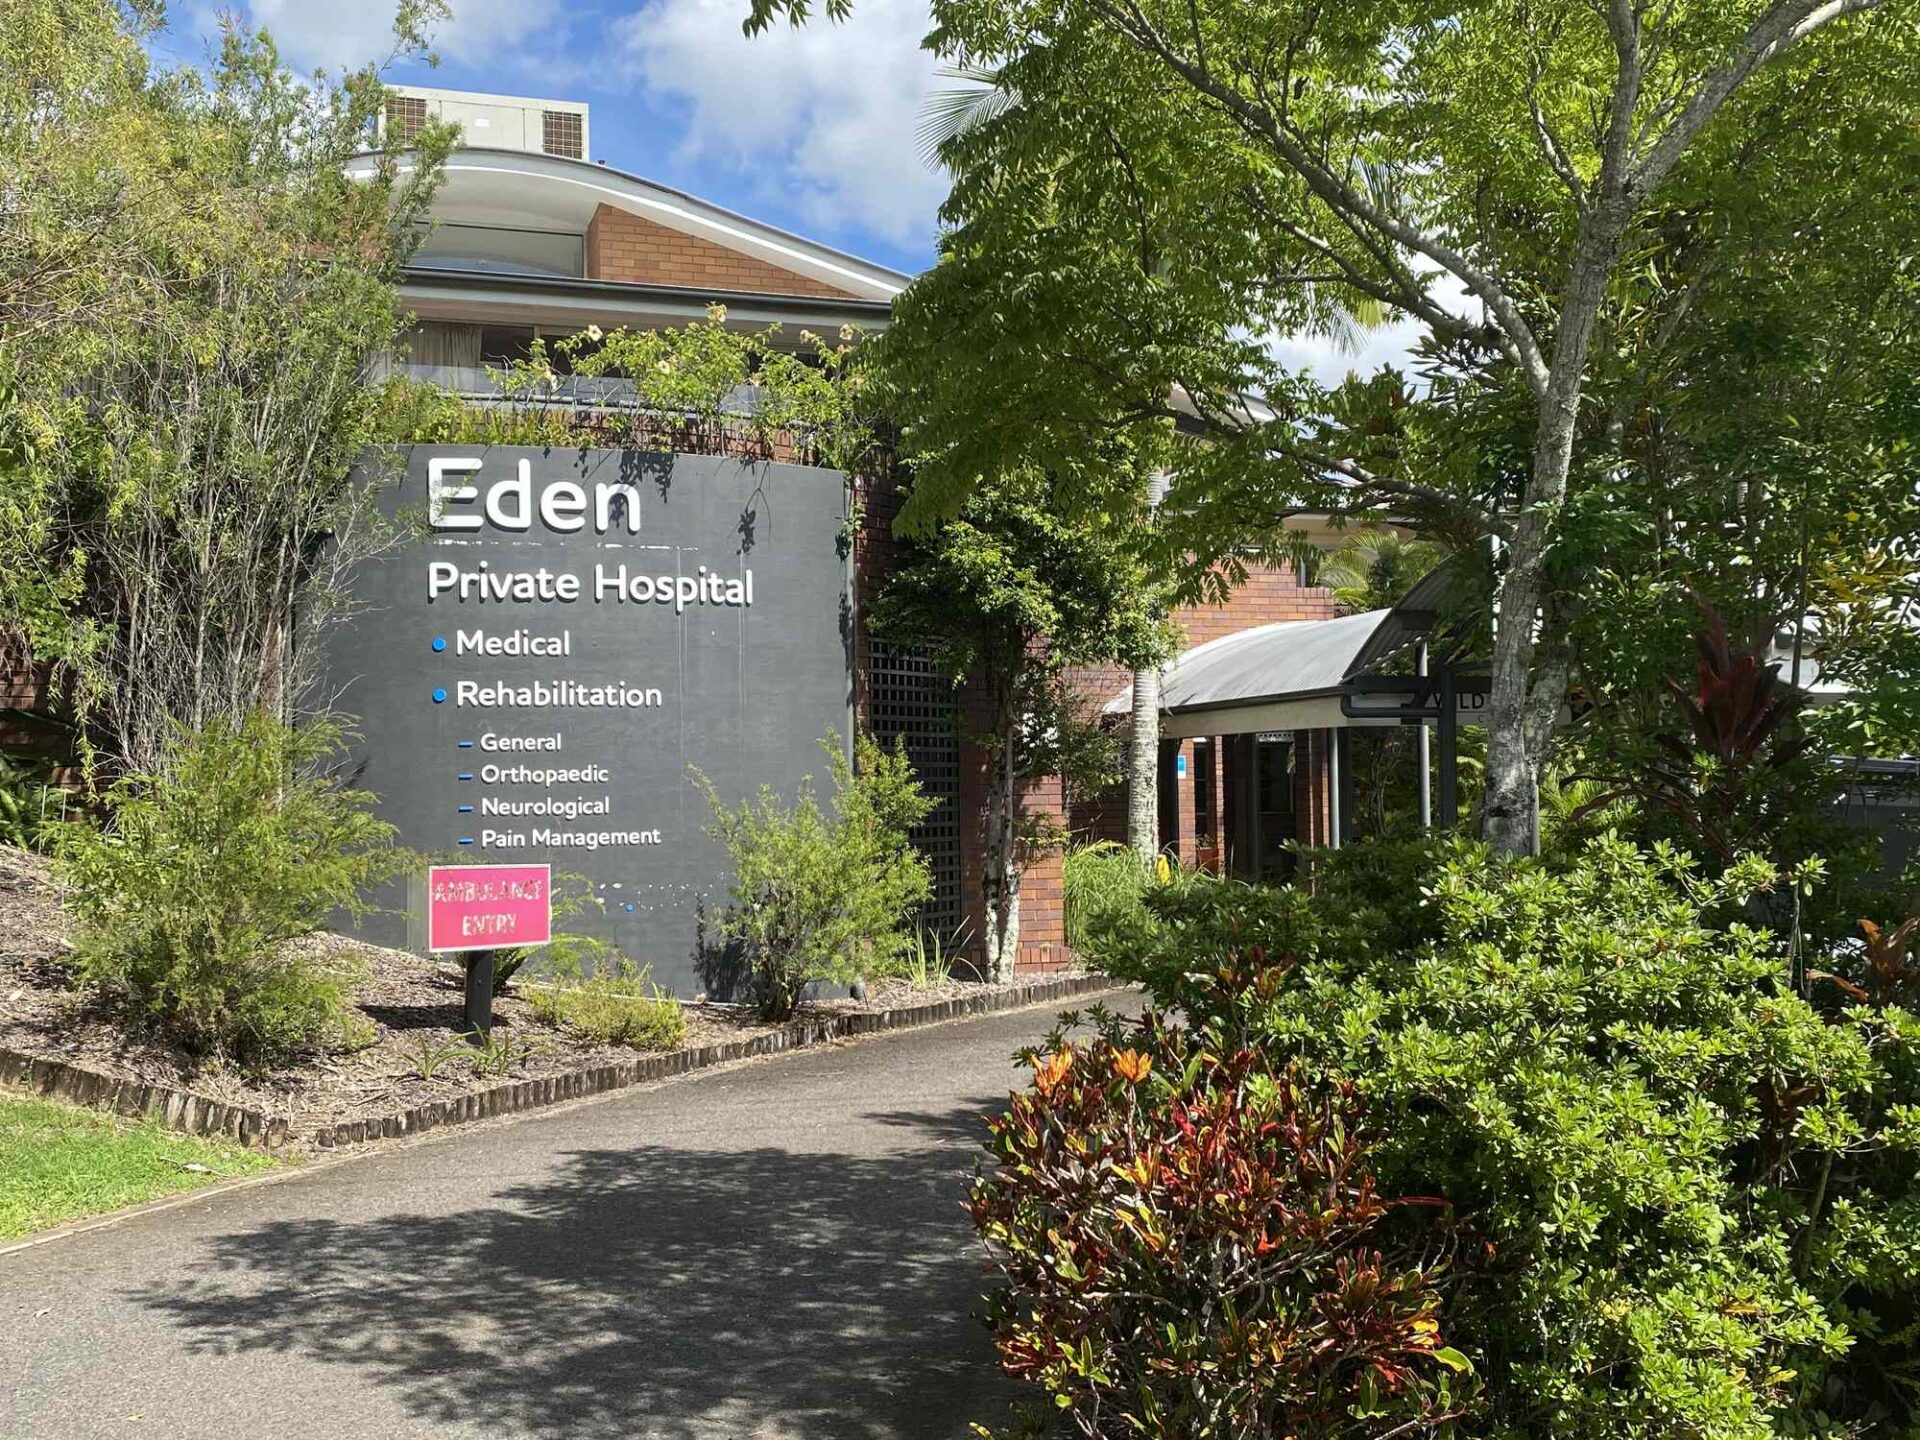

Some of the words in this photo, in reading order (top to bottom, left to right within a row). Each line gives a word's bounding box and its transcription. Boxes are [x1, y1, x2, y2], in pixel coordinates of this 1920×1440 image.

[428, 457, 642, 533] Eden
[428, 560, 581, 601] Private
[595, 563, 754, 613] Hospital
[456, 629, 571, 657] Medical
[456, 680, 663, 708] Rehabilitation
[1433, 693, 1485, 709] WLD
[480, 733, 563, 752] General
[480, 764, 610, 788] Orthopaedic
[481, 796, 610, 820] Neurological
[481, 829, 526, 849] Pain
[532, 829, 662, 851] Management
[462, 913, 518, 937] ENTRY
